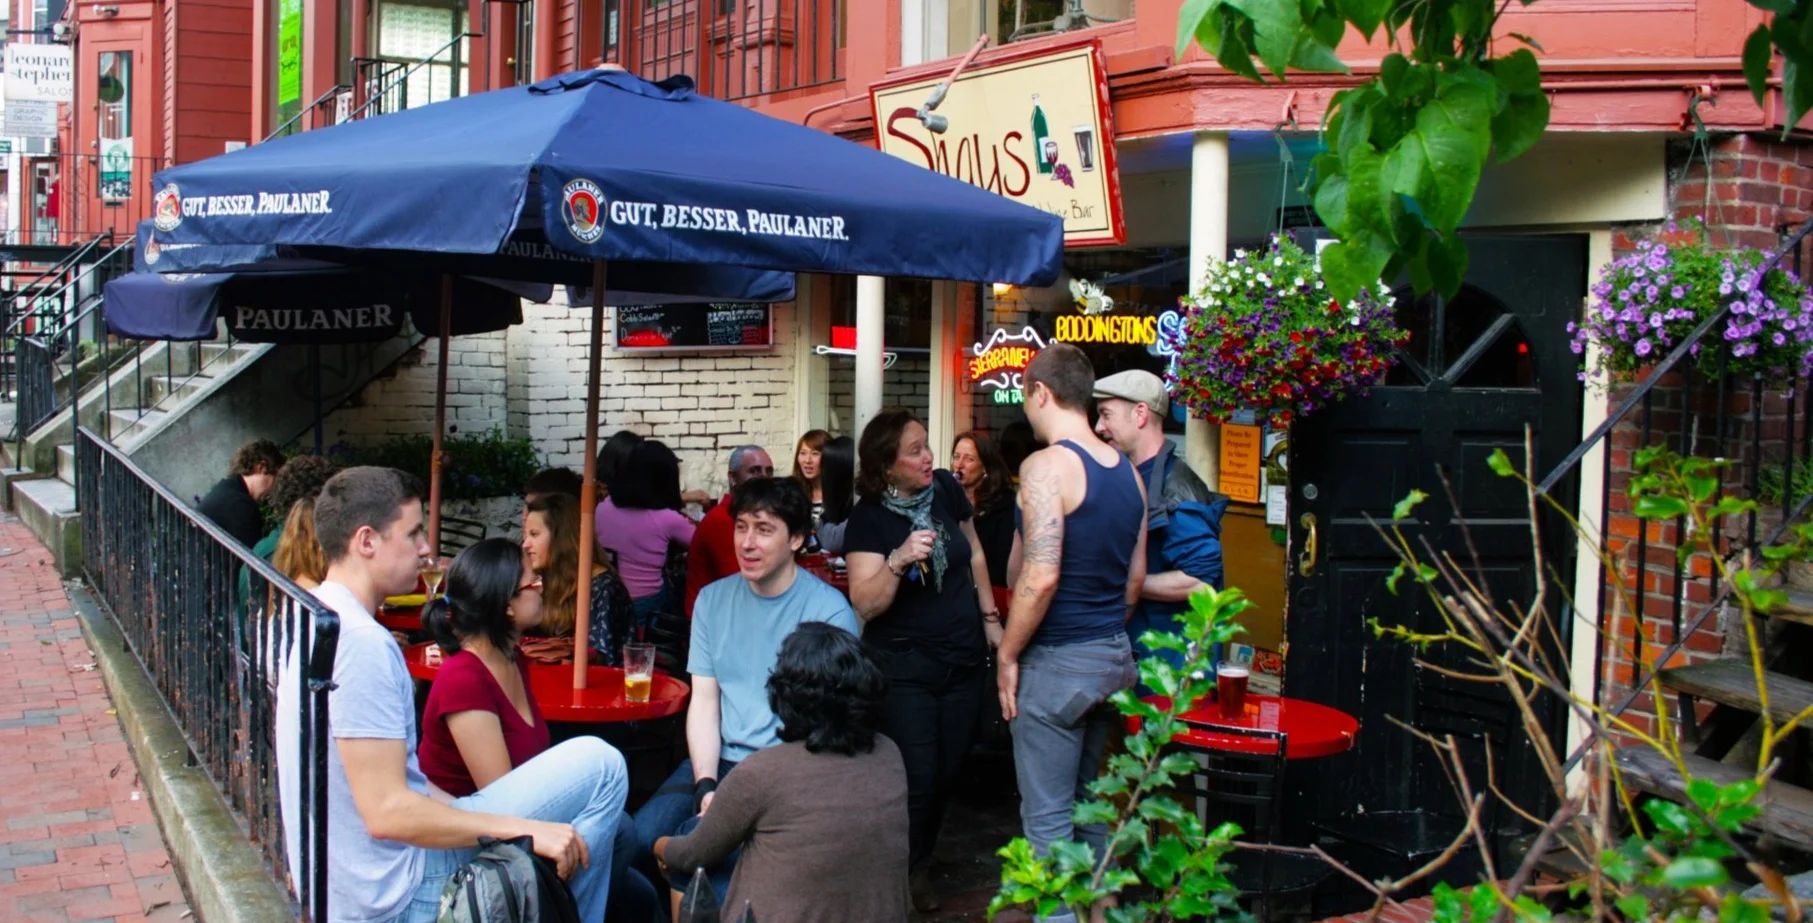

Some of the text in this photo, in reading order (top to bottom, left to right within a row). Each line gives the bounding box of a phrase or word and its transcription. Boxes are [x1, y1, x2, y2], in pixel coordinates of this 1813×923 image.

[182, 197, 206, 219] GUT,
[207, 195, 255, 217] BESSER,
[257, 190, 332, 215] PAULANER.
[610, 201, 849, 241] GUT, BESSER, PAULANER.
[234, 303, 394, 330] PAULANER
[1056, 315, 1157, 344] BODDINGTONS
[969, 347, 1010, 380] SIERRA
[994, 389, 1025, 403] ON TA
